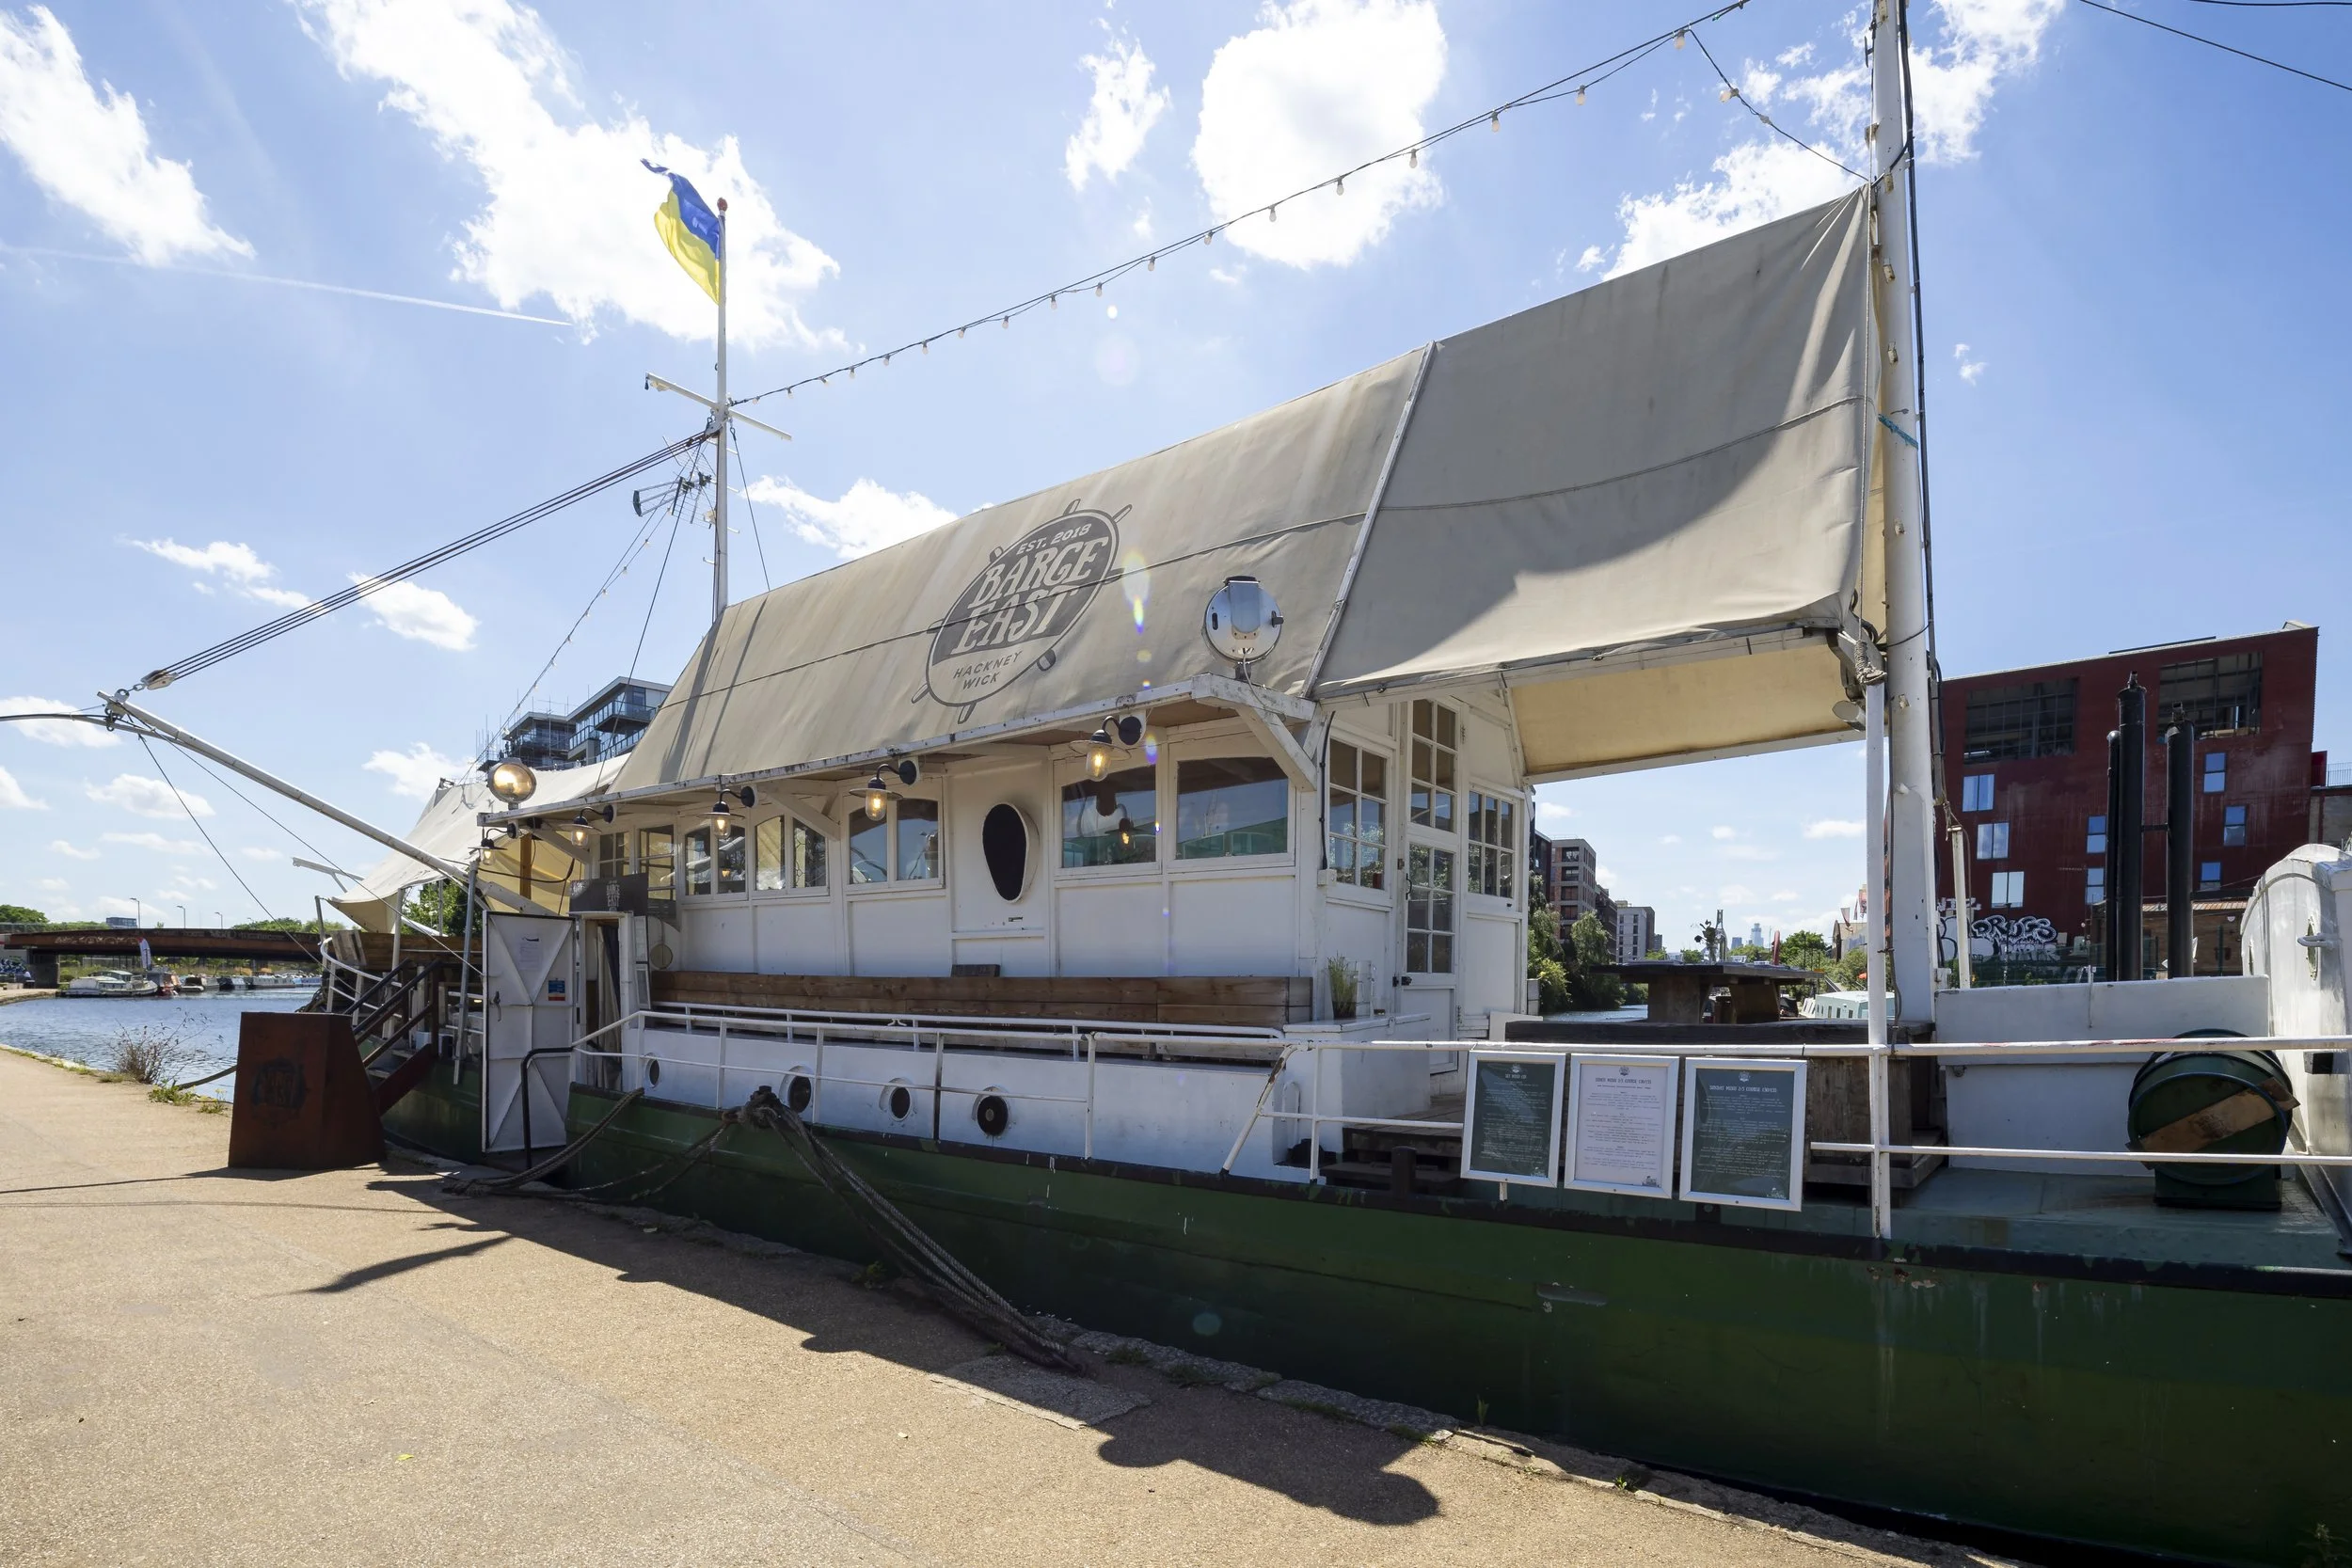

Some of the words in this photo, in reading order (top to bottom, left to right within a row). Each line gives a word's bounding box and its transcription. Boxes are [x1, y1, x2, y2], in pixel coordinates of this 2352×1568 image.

[1016, 541, 1046, 556] EST.
[1050, 523, 1092, 546] 2018
[967, 536, 1109, 609] BARGE
[950, 585, 1080, 655] EAST
[953, 651, 1023, 679] HACKNEY
[962, 672, 1000, 690] WICK
[1971, 914, 2058, 943] DRUGS
